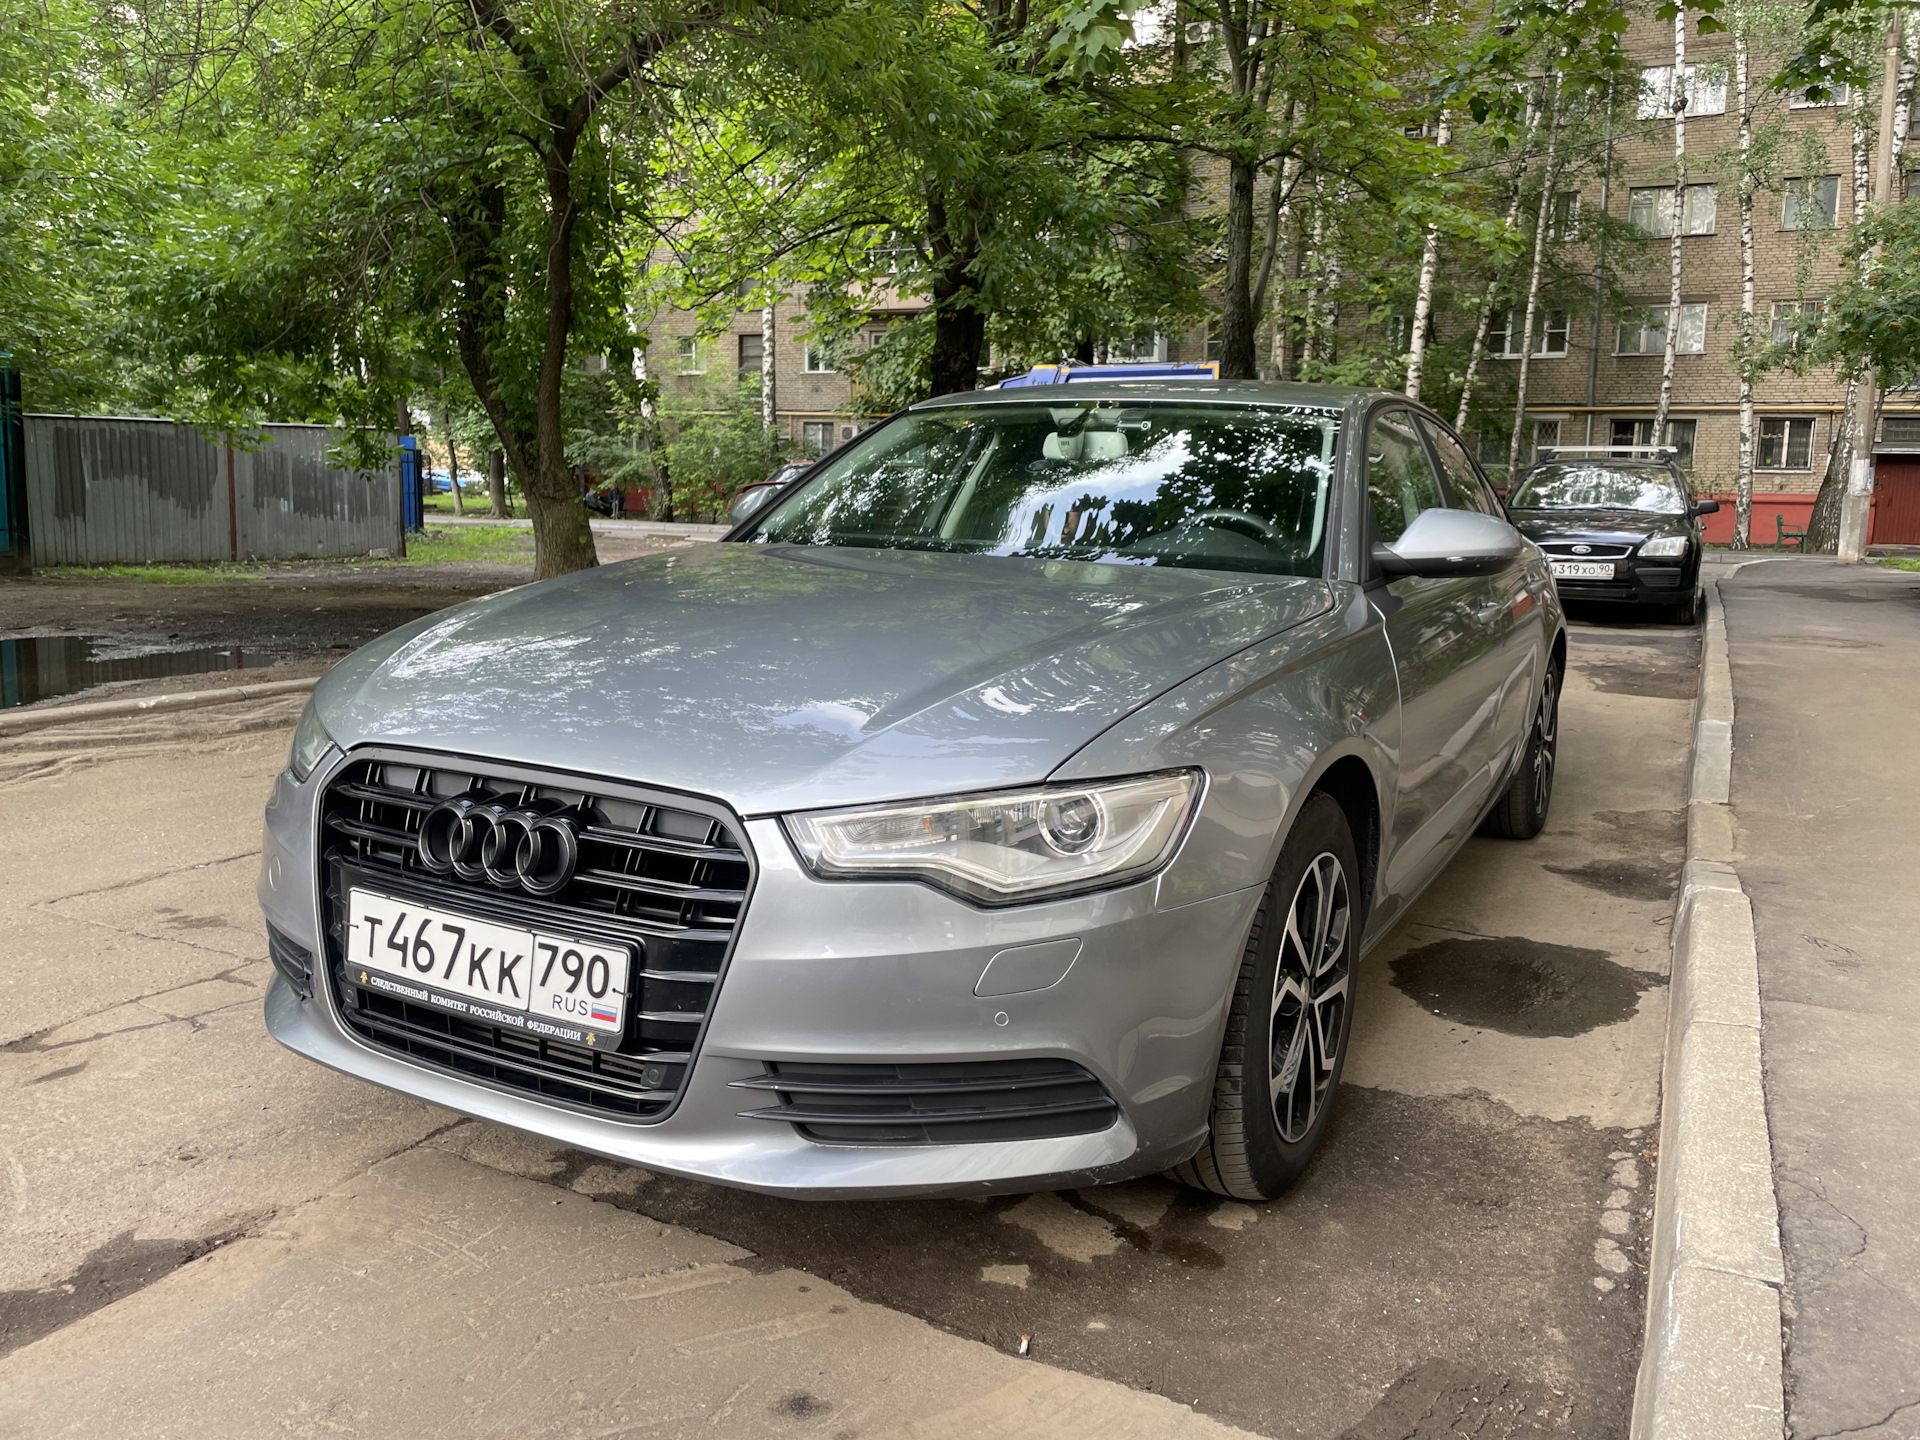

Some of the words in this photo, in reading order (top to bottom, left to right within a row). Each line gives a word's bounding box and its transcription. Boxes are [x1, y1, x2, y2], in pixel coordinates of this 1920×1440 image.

[364, 912, 524, 999] Т467КК
[537, 942, 610, 999] 790
[370, 976, 429, 1002] СЛЕДСТВЕННЫЙ
[430, 993, 468, 1013] КОМИТЕТ
[469, 1003, 524, 1028] РОССИЙСКОЙ
[527, 1019, 581, 1042] ФЕДЕРАЦИИ
[552, 994, 588, 1016] RUS
